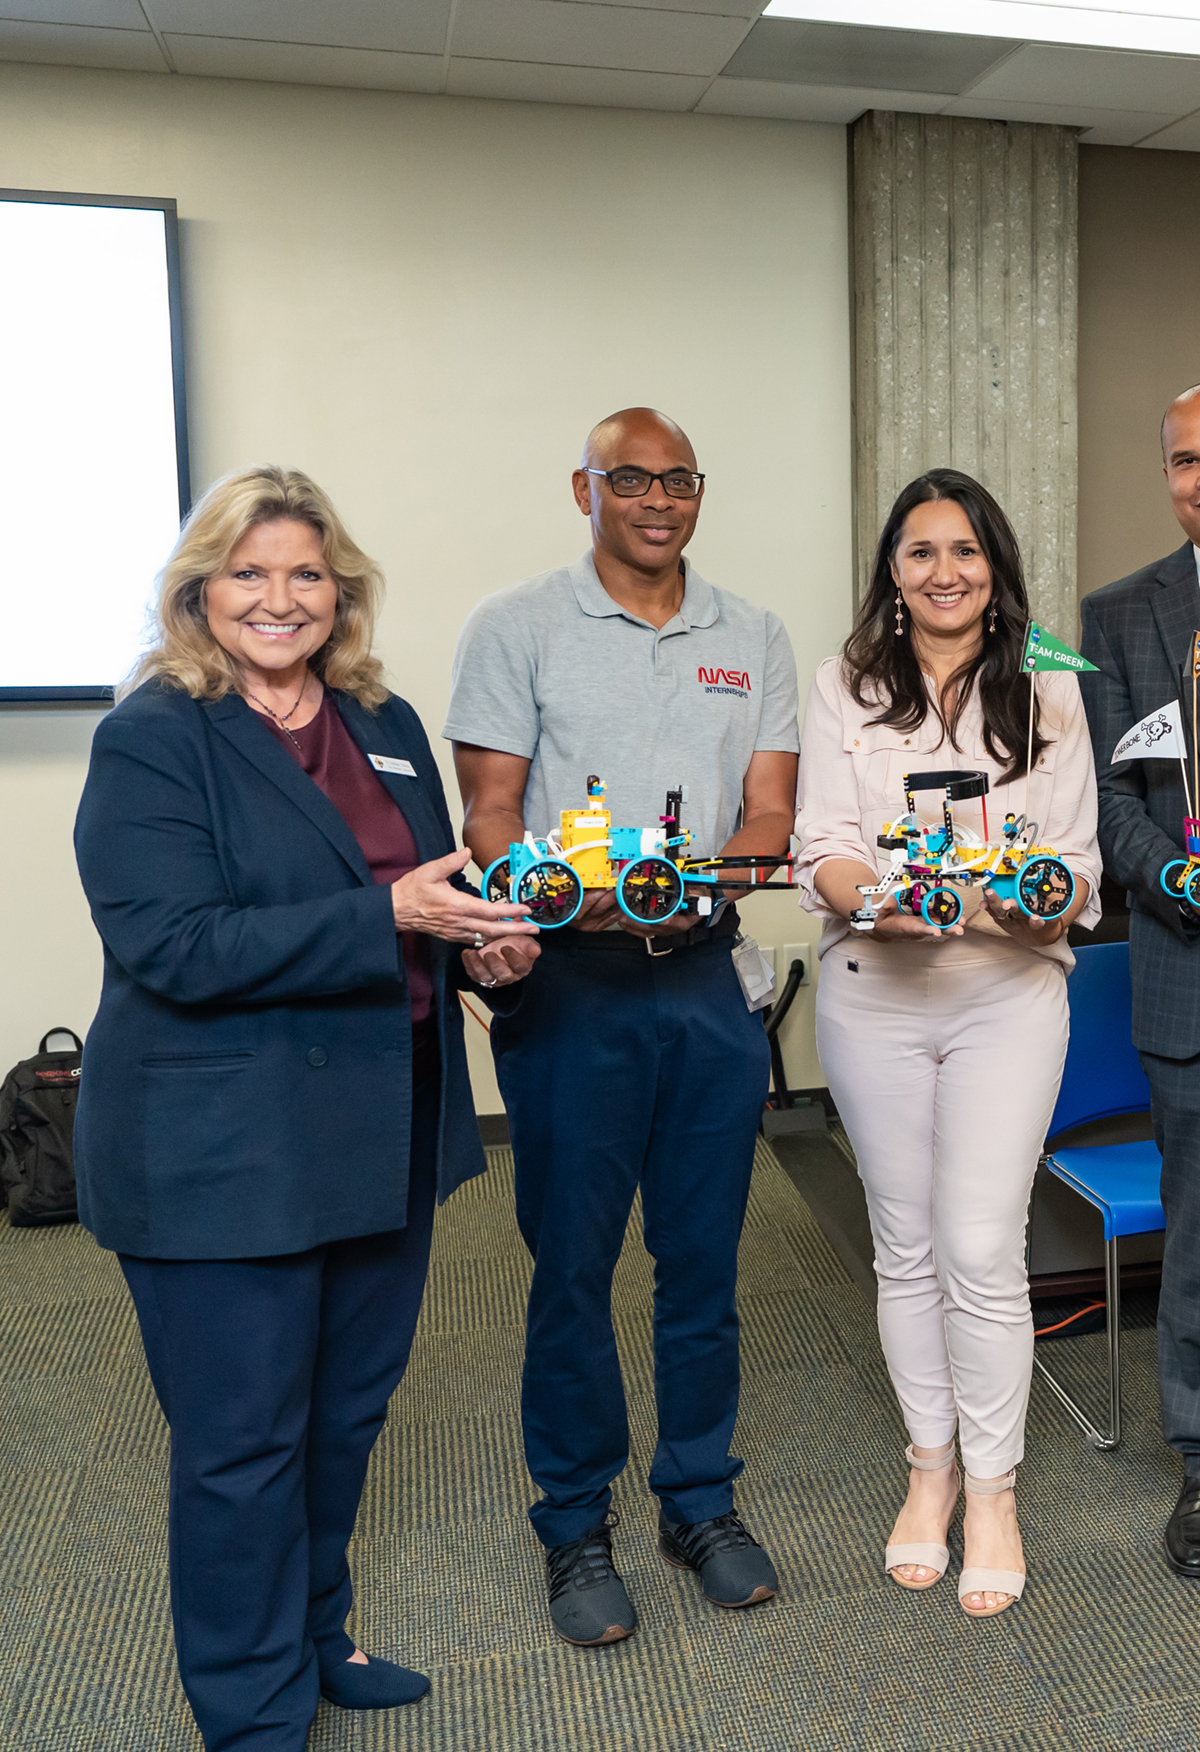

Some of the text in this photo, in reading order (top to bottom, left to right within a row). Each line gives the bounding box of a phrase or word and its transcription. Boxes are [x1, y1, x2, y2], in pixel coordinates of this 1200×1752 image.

[1029, 642, 1053, 658] TEAM
[1054, 651, 1084, 669] GREEN
[698, 667, 751, 690] NASA
[705, 687, 748, 699] INTERNSHIPS
